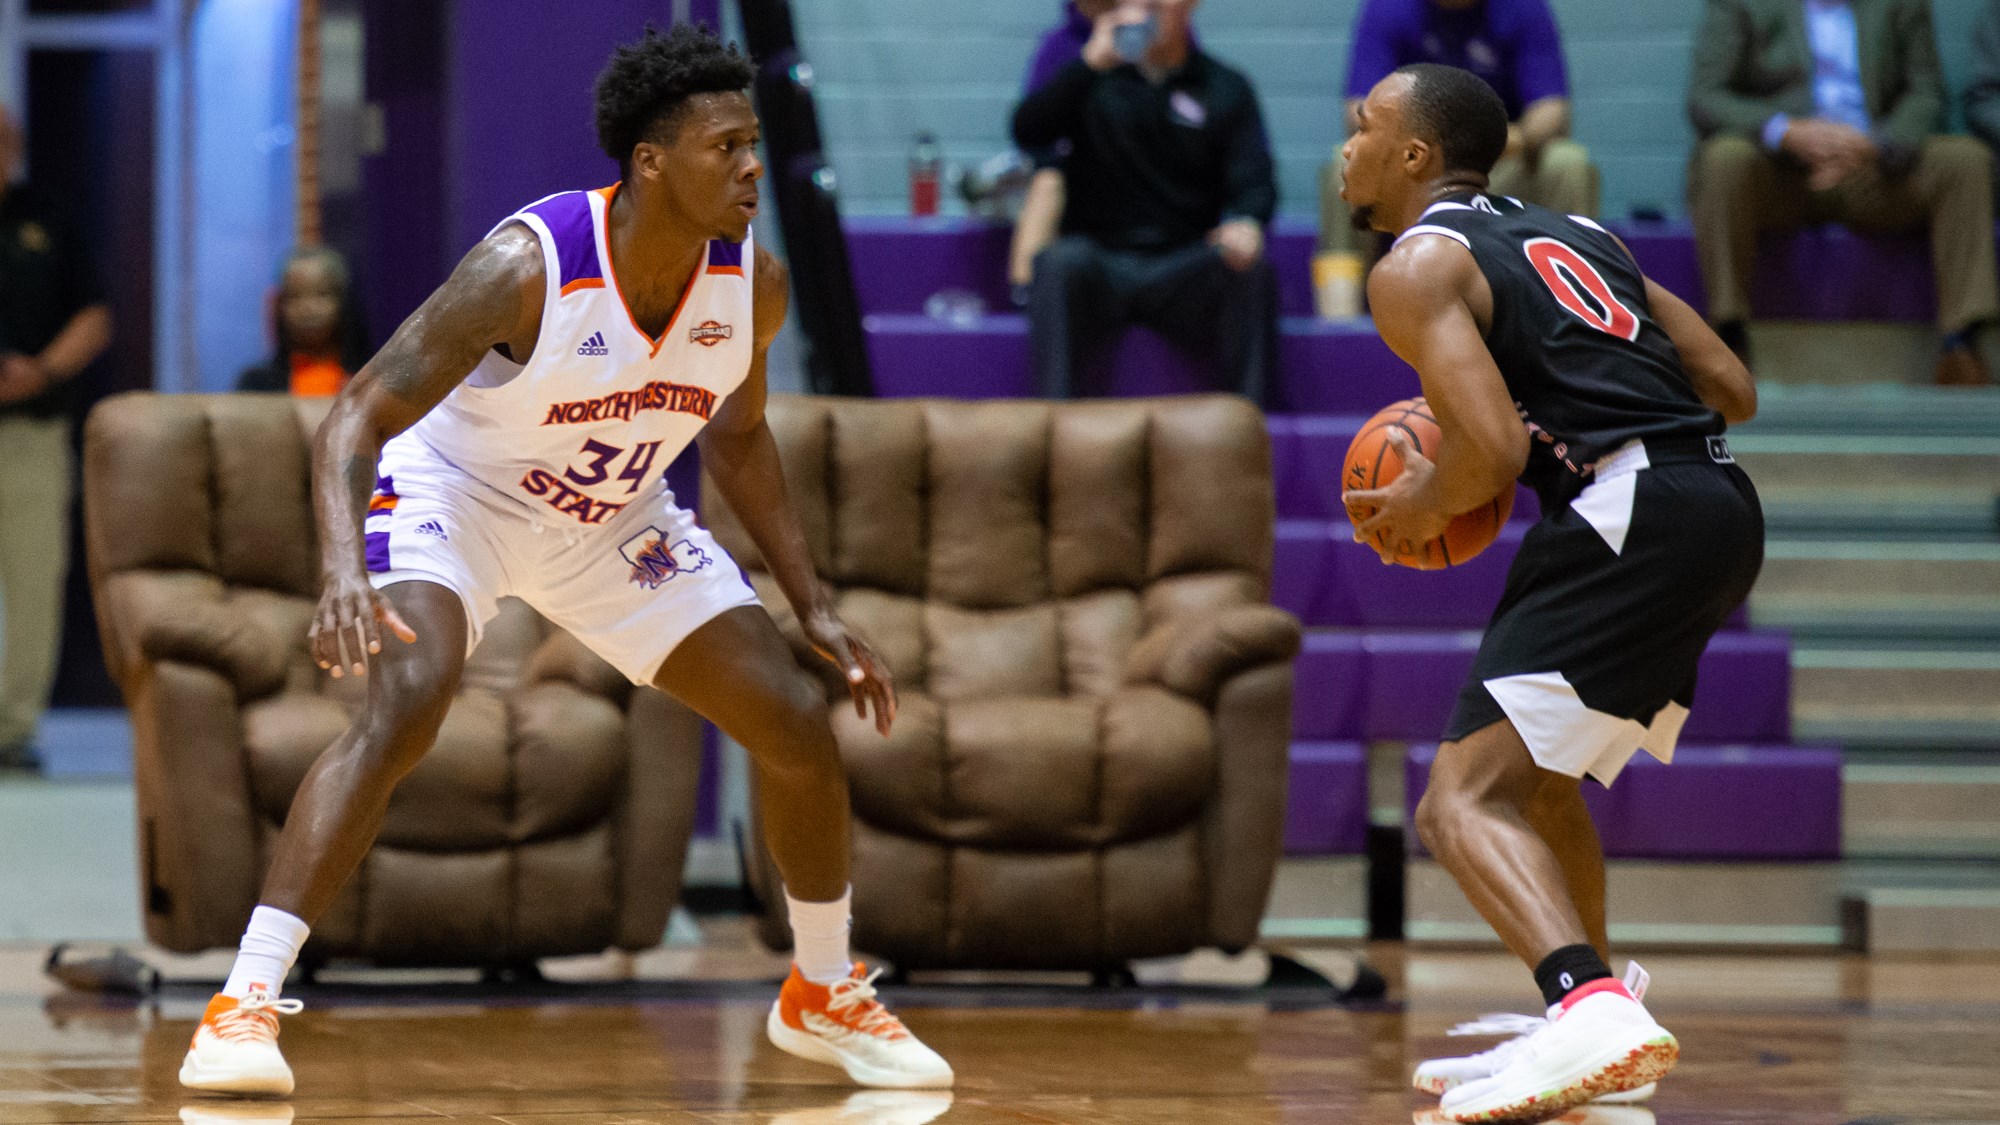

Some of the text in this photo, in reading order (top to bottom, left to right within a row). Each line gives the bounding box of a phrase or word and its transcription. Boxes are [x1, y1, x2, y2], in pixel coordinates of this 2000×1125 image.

[1523, 237, 1640, 342] 0
[564, 437, 665, 494] 34
[519, 468, 628, 525] STAT
